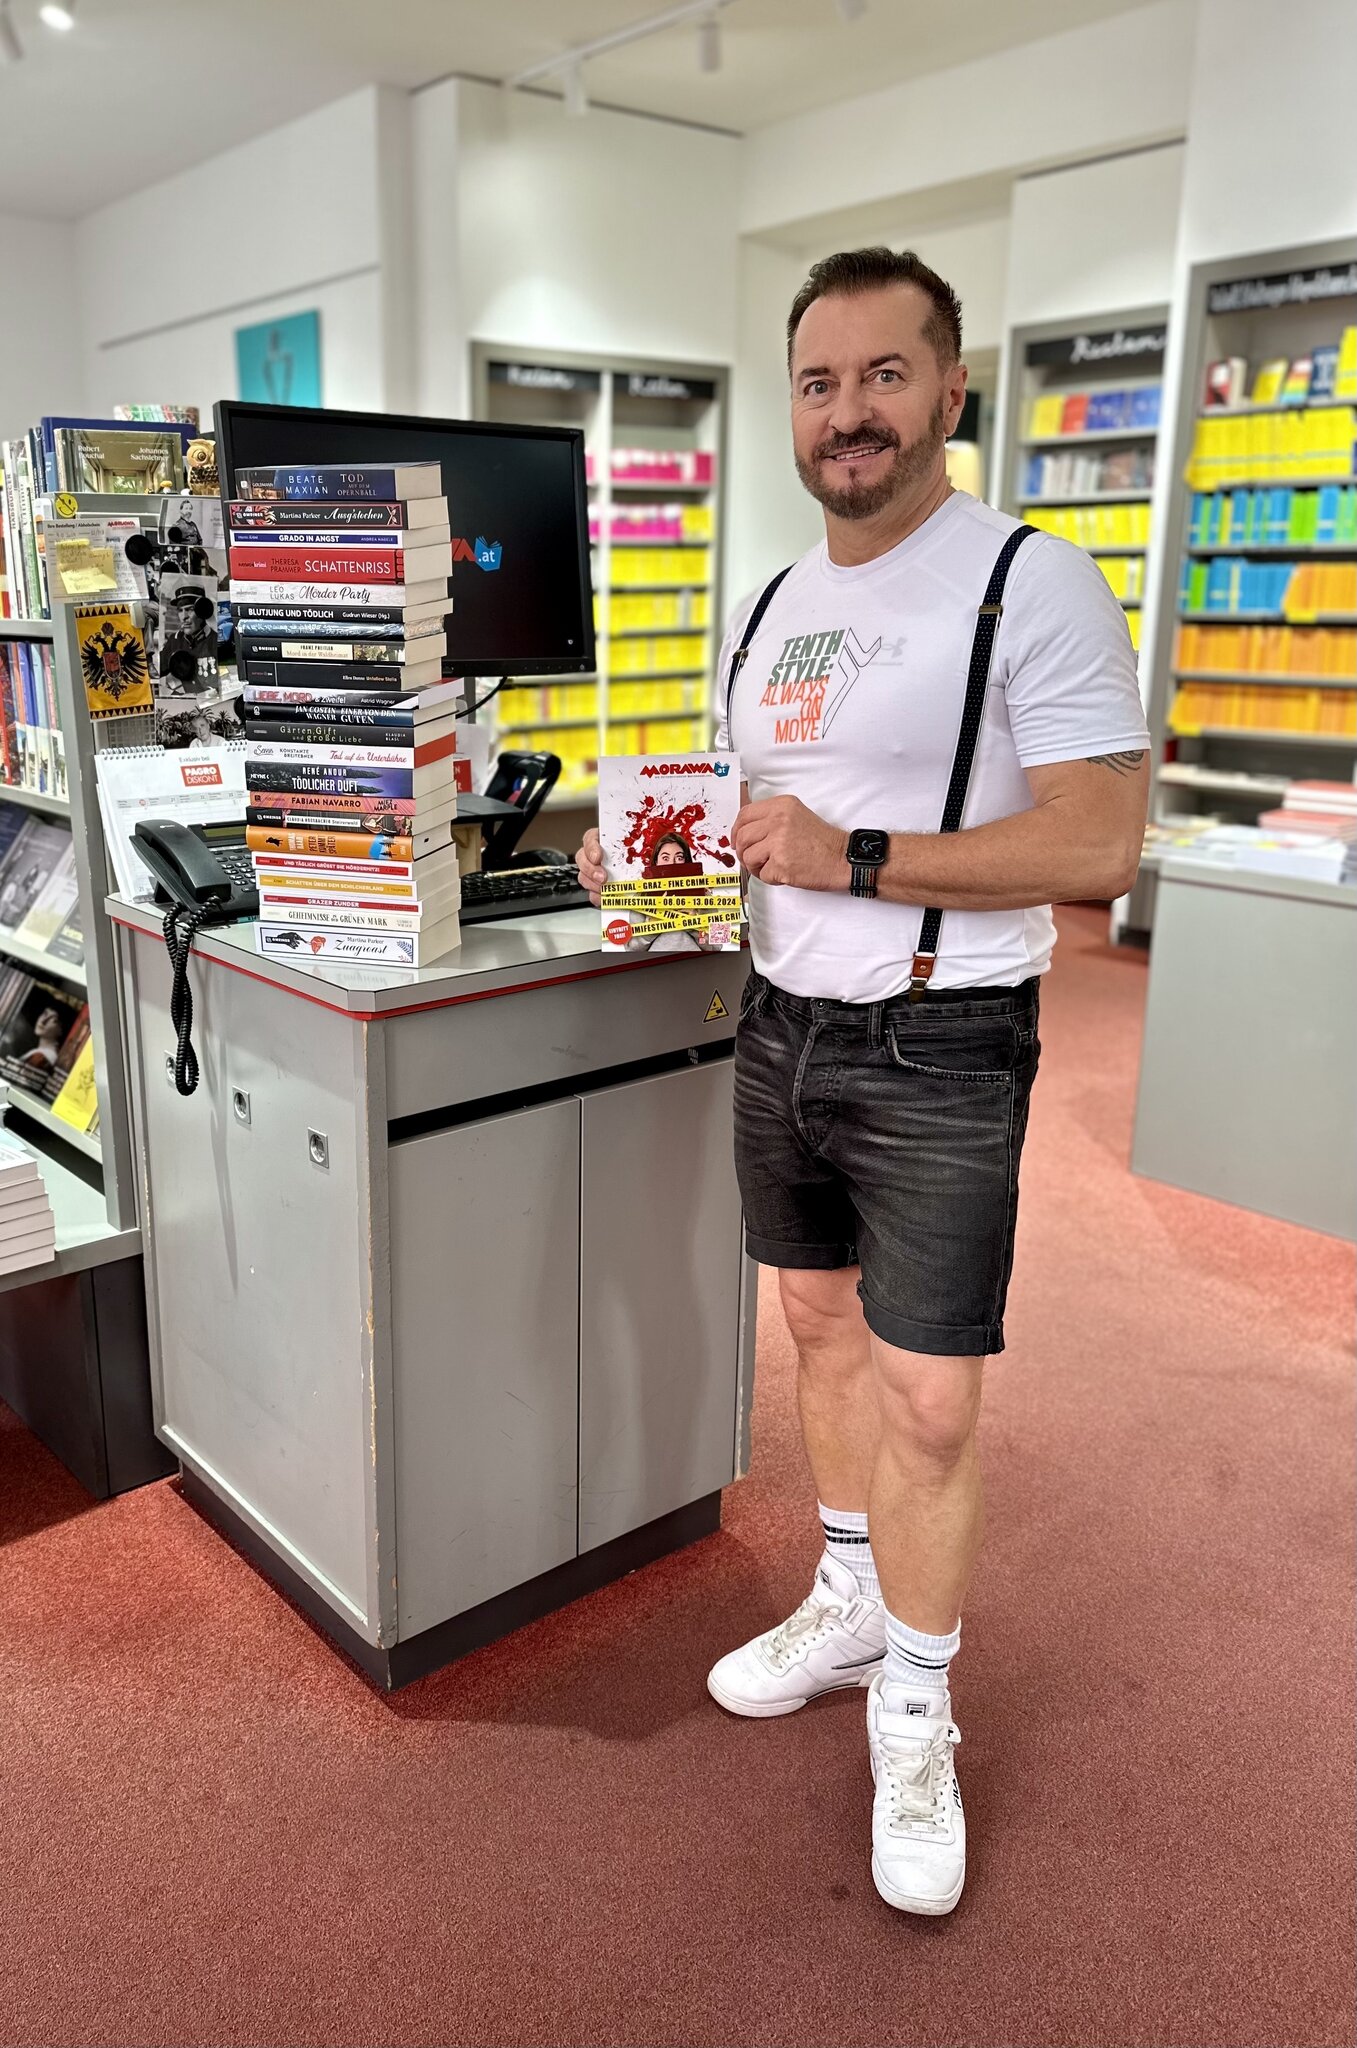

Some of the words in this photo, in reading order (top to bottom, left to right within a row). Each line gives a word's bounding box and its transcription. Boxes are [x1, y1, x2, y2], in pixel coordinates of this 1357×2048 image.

[289, 475, 323, 484] BEATE
[340, 474, 364, 483] TOD
[286, 486, 328, 494] MAXIAN
[478, 550, 495, 562] .at
[305, 560, 390, 574] SCHATTENRISS
[299, 586, 338, 599] Mörder
[340, 587, 371, 604] Party
[248, 608, 284, 617] BLUTJUNG
[303, 609, 334, 618] TÖDLICH
[779, 629, 846, 662] TENTH
[759, 675, 829, 707] ALWAYS
[283, 692, 313, 702] MORD
[321, 695, 346, 704] Zweifel
[309, 706, 336, 714] COSTIN
[801, 692, 824, 722] ON
[341, 715, 375, 724] GUTEN
[315, 727, 337, 736] Gift
[775, 717, 819, 744] MOVE
[307, 734, 336, 742] große
[330, 751, 343, 760] Tod
[344, 753, 355, 762] auf
[367, 752, 407, 763] Unterbühne
[185, 768, 217, 776] PAGRO
[302, 767, 320, 775] RENÉ
[324, 768, 347, 776] ANOUR
[640, 763, 714, 778] MORAWA
[186, 776, 218, 784] DISKONT
[292, 776, 335, 791] TÖDLICHER
[338, 780, 358, 792] DUFT
[323, 799, 361, 807] NAVARRO
[668, 880, 684, 888] FINE
[686, 878, 709, 887] CRIME
[602, 898, 656, 906] KRIMIFESTIVAL
[693, 898, 736, 906] 13.06.2024
[289, 911, 330, 921] GEHEIMNISSE
[340, 913, 365, 924] GRÜNEN
[368, 917, 387, 926] MARK
[683, 918, 701, 927] GRAZ
[708, 915, 723, 923] FINE
[333, 940, 388, 956] Zuagroast
[953, 1778, 962, 1809] FILA
